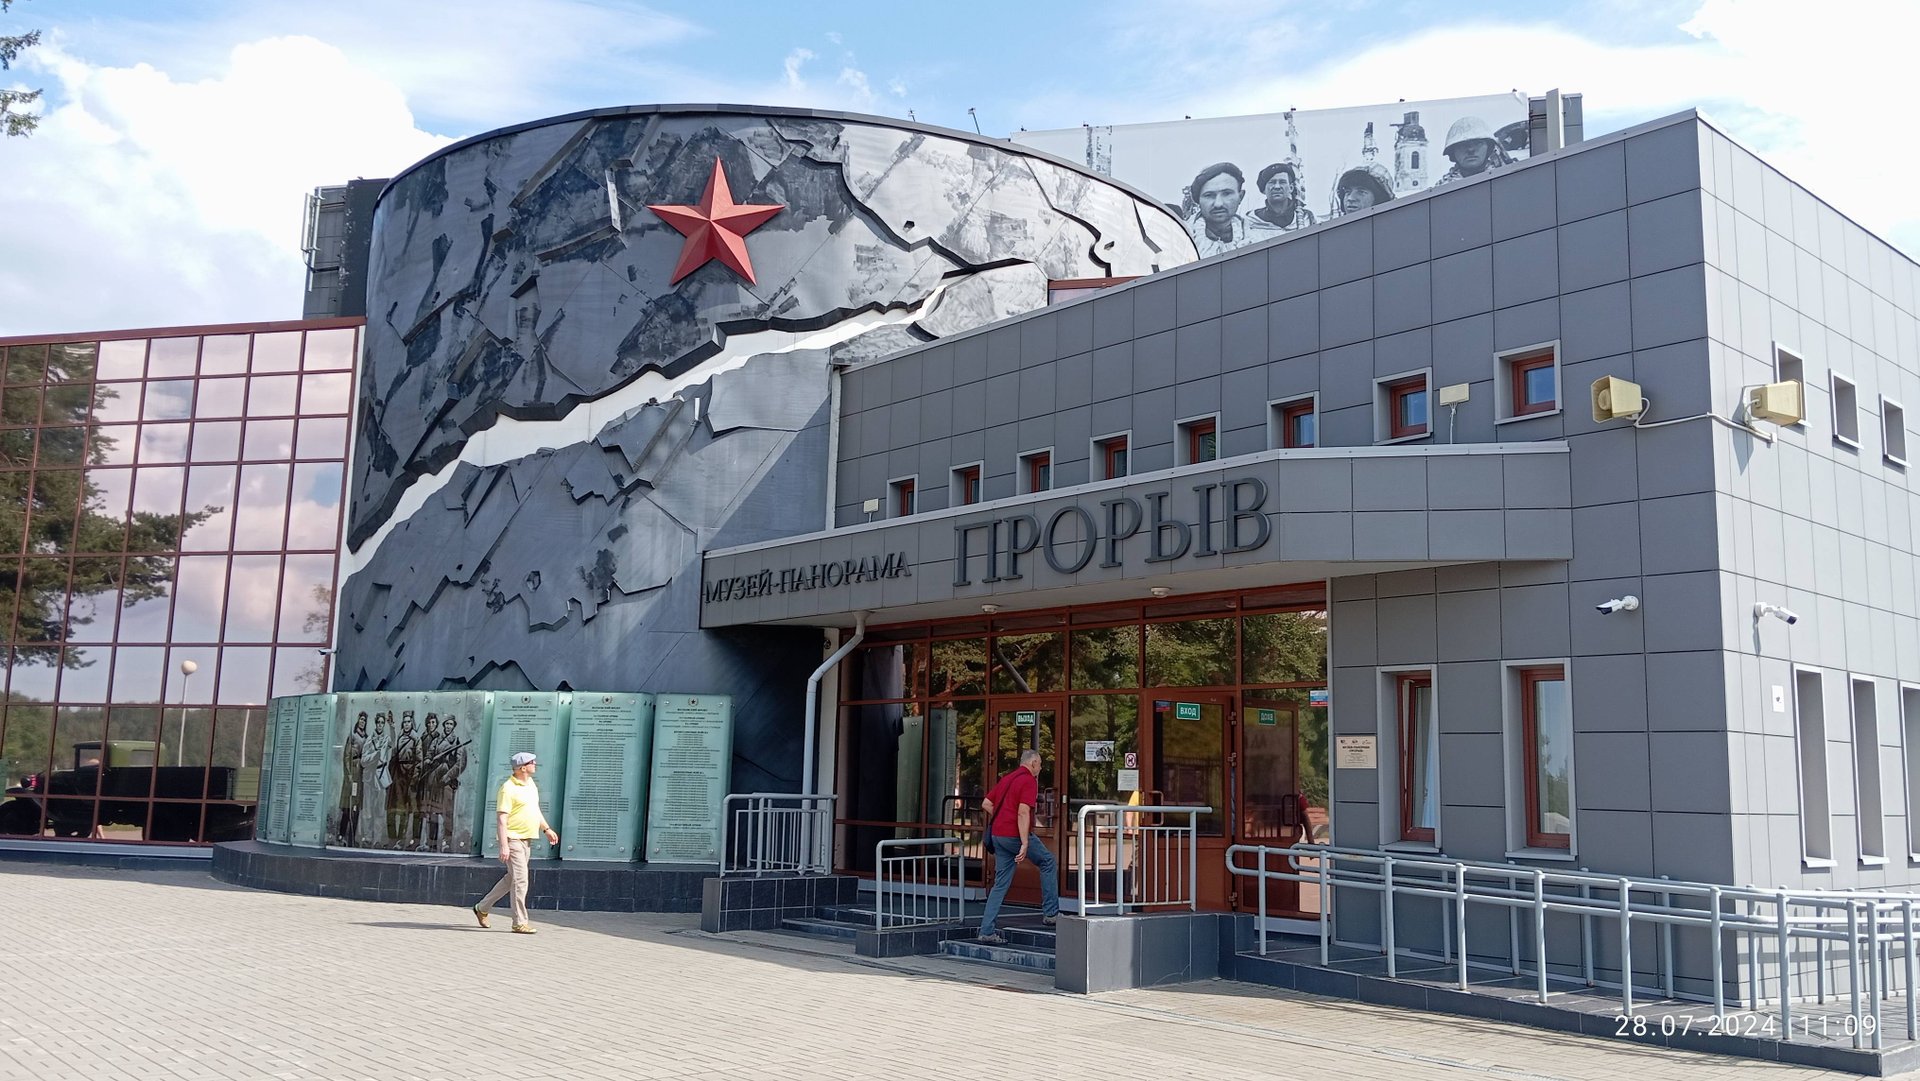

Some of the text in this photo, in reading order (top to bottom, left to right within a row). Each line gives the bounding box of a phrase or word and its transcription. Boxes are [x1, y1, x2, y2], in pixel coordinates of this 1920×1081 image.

[702, 476, 1272, 604] МУЗЕЙ-ПАНОРАМА ПРОРЫВ
[1180, 706, 1197, 717] ВХОД
[1017, 714, 1034, 723] ВЫХОД
